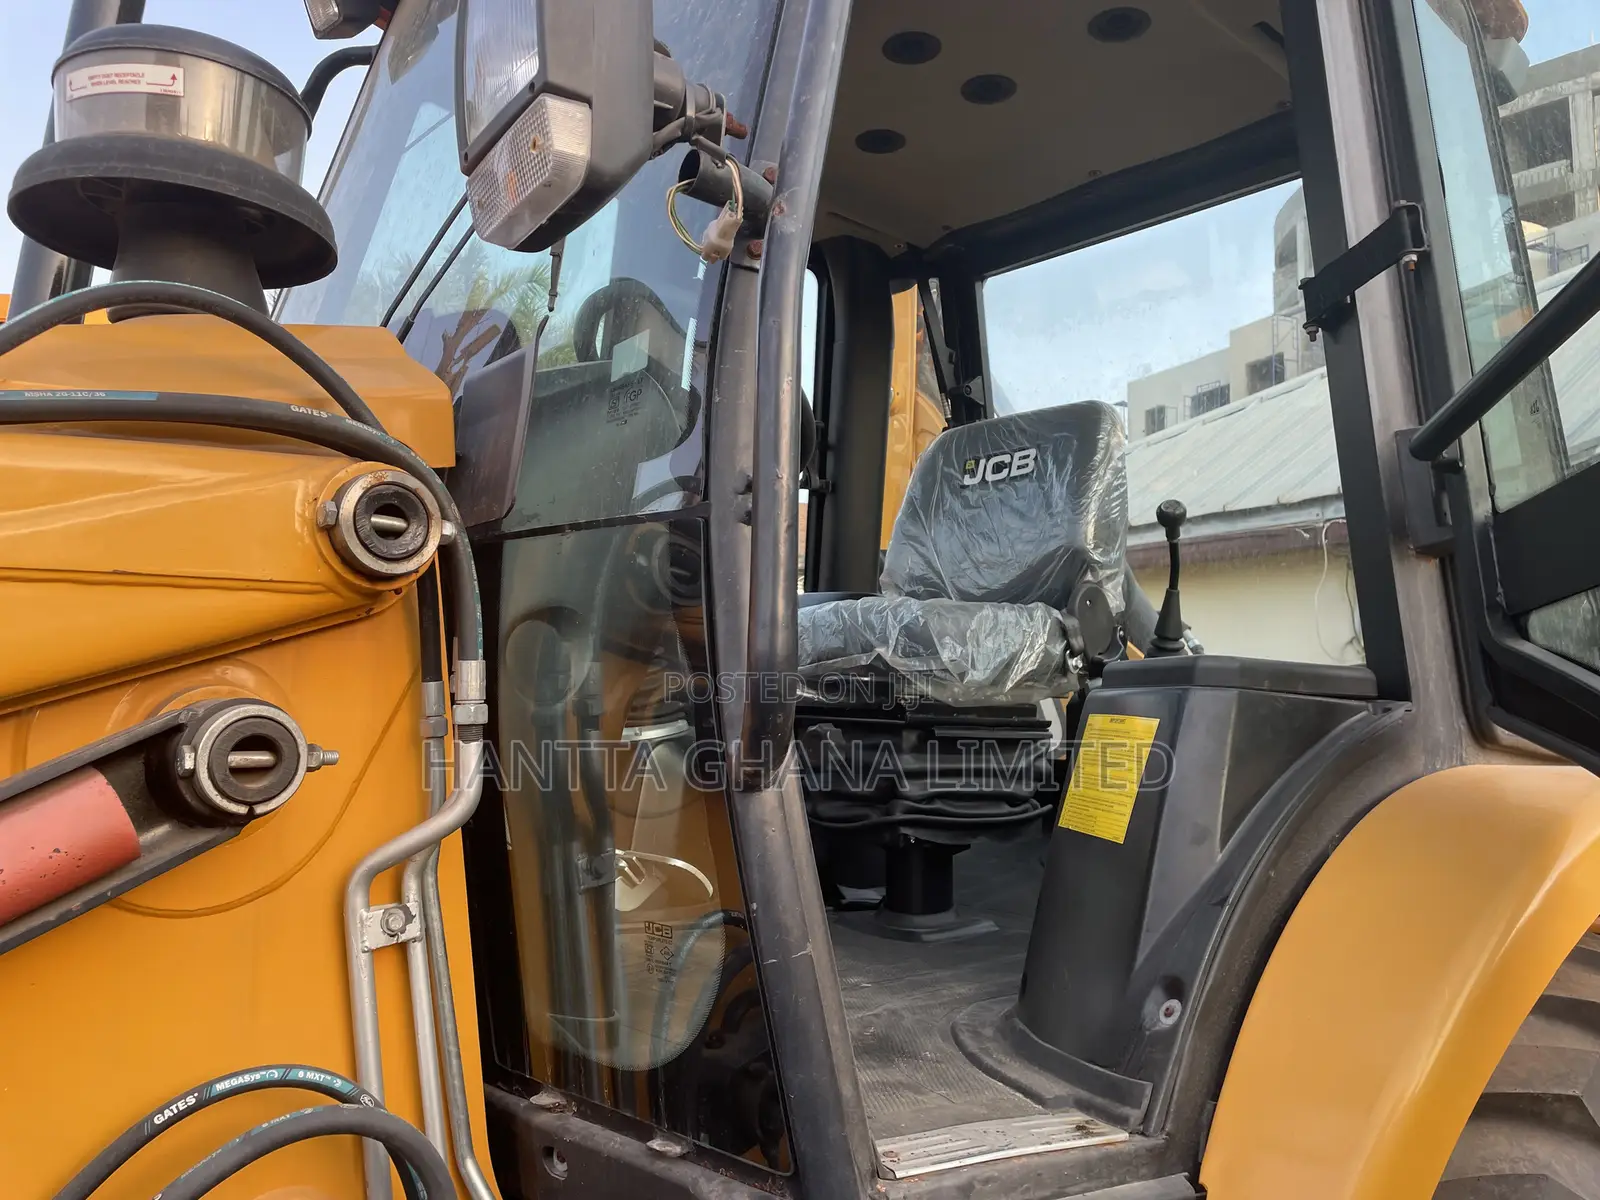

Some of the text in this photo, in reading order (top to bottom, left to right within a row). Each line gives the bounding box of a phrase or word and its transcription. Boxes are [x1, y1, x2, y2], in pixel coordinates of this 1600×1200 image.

[290, 403, 329, 419] GATES
[963, 448, 1037, 485] JCB
[645, 921, 672, 939] JCB
[153, 1094, 197, 1125] GATES
